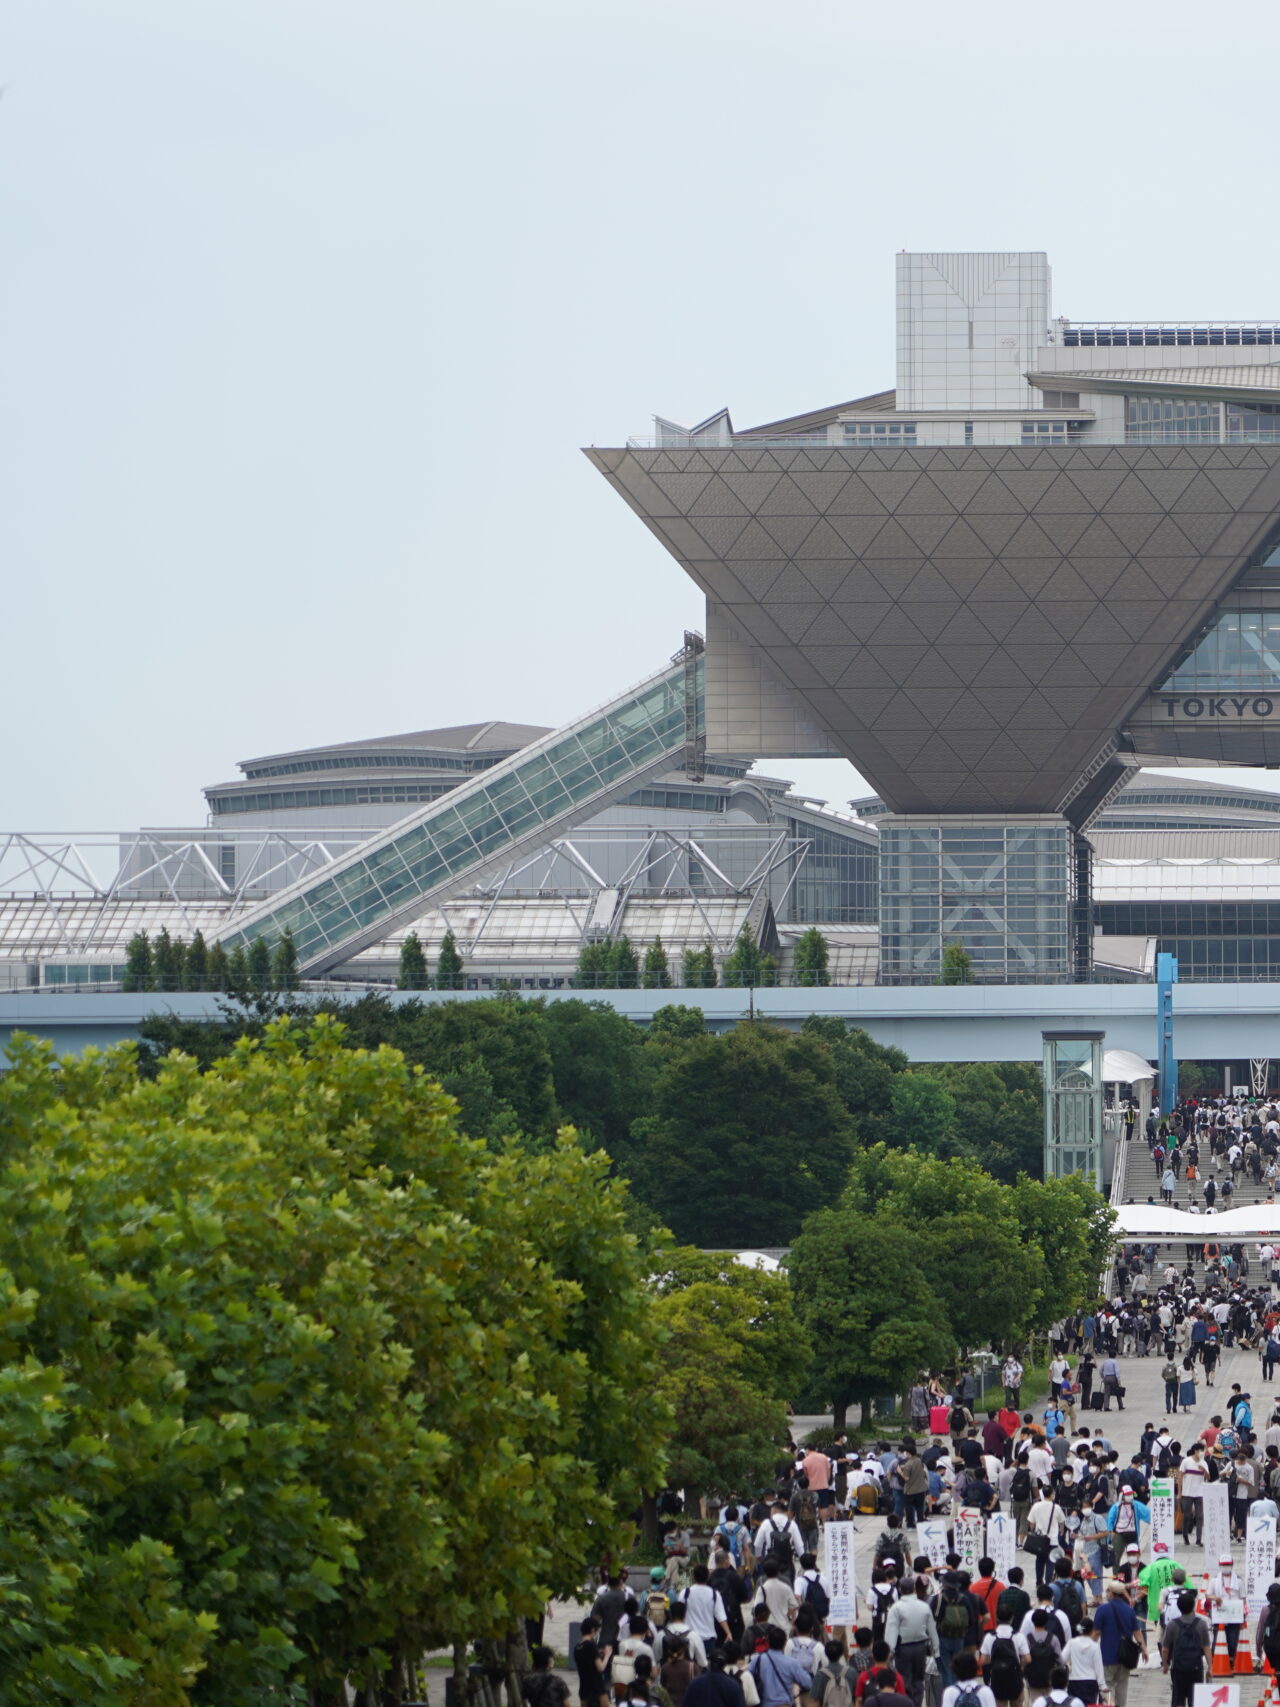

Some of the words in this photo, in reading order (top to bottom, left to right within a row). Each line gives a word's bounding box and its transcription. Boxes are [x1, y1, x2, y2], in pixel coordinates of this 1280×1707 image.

[1161, 697, 1273, 718] TOKYO
[841, 1527, 849, 1596] ご質問がありましたら
